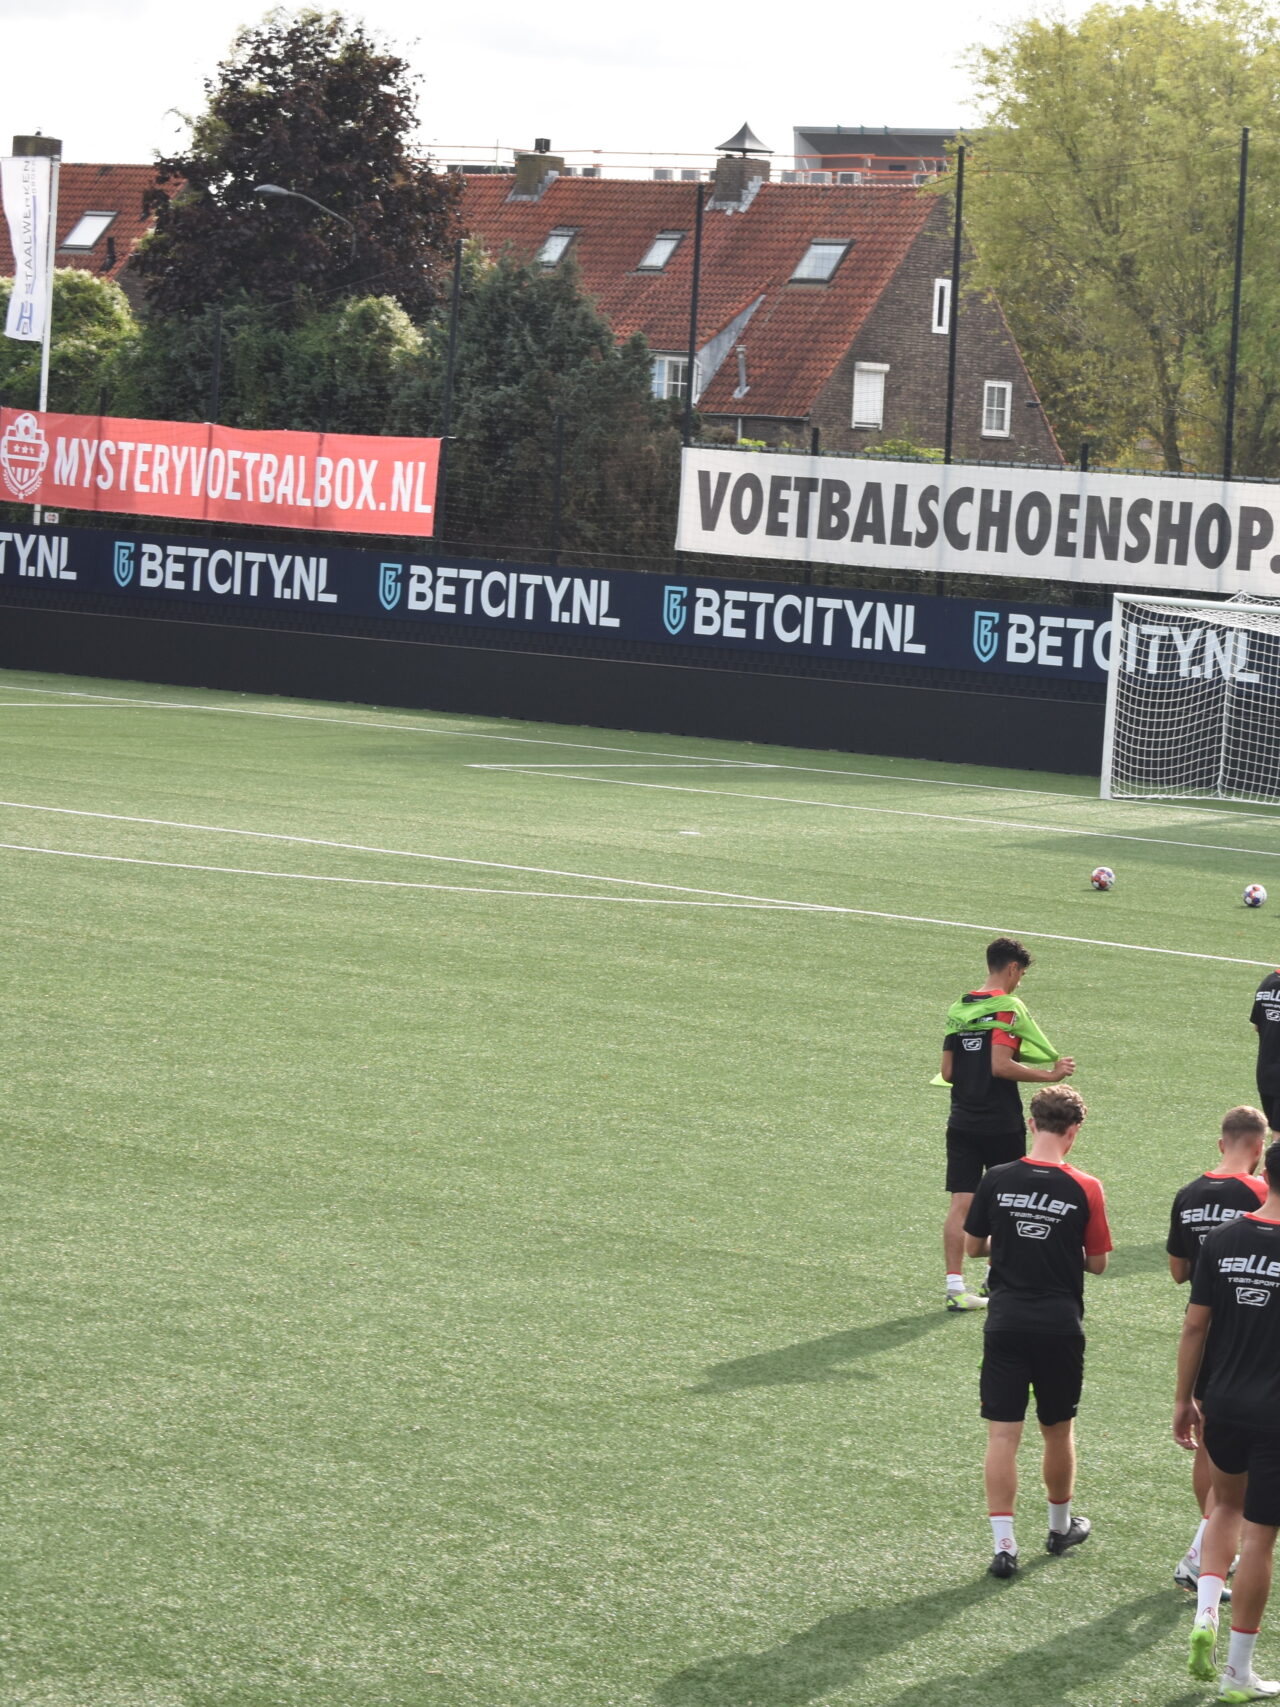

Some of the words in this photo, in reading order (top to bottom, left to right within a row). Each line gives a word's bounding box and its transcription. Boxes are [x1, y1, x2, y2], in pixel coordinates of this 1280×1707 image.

[54, 436, 432, 514] MYSTERYVOETBALBOX.NL
[139, 543, 338, 603] BETCITY.NL
[407, 565, 621, 628] BETCITY.NL
[693, 588, 927, 654] BETCITY.NL
[997, 1192, 1078, 1216] saller
